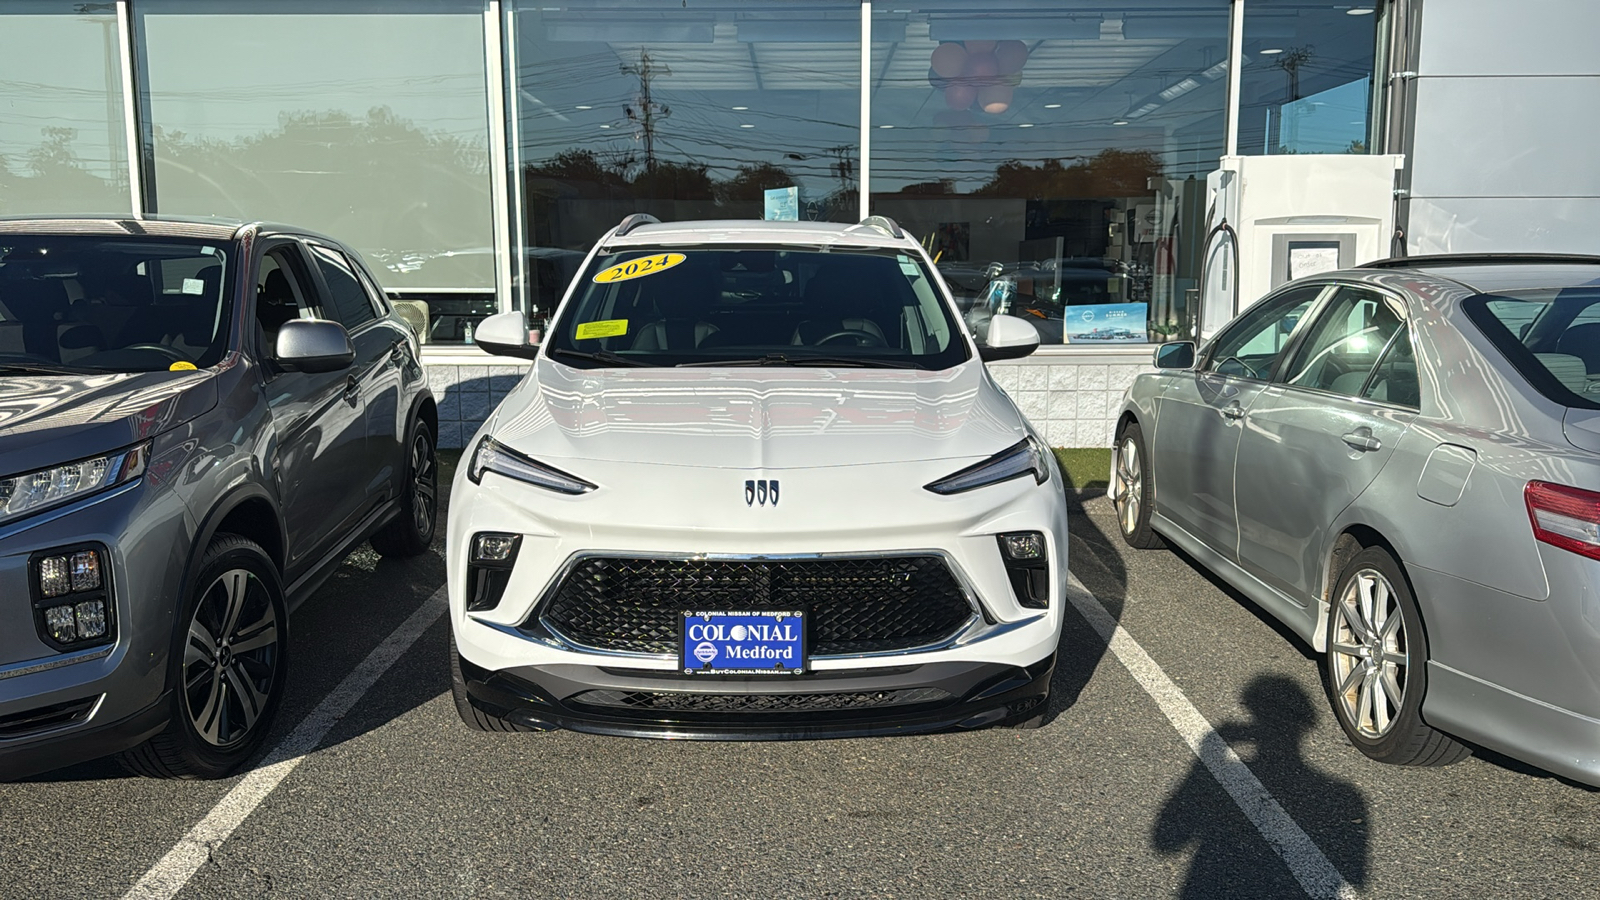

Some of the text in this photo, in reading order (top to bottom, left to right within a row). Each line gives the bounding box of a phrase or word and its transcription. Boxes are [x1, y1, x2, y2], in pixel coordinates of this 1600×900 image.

[610, 255, 669, 280] 2024
[688, 624, 798, 641] COLONIAL
[725, 645, 793, 659] Medford
